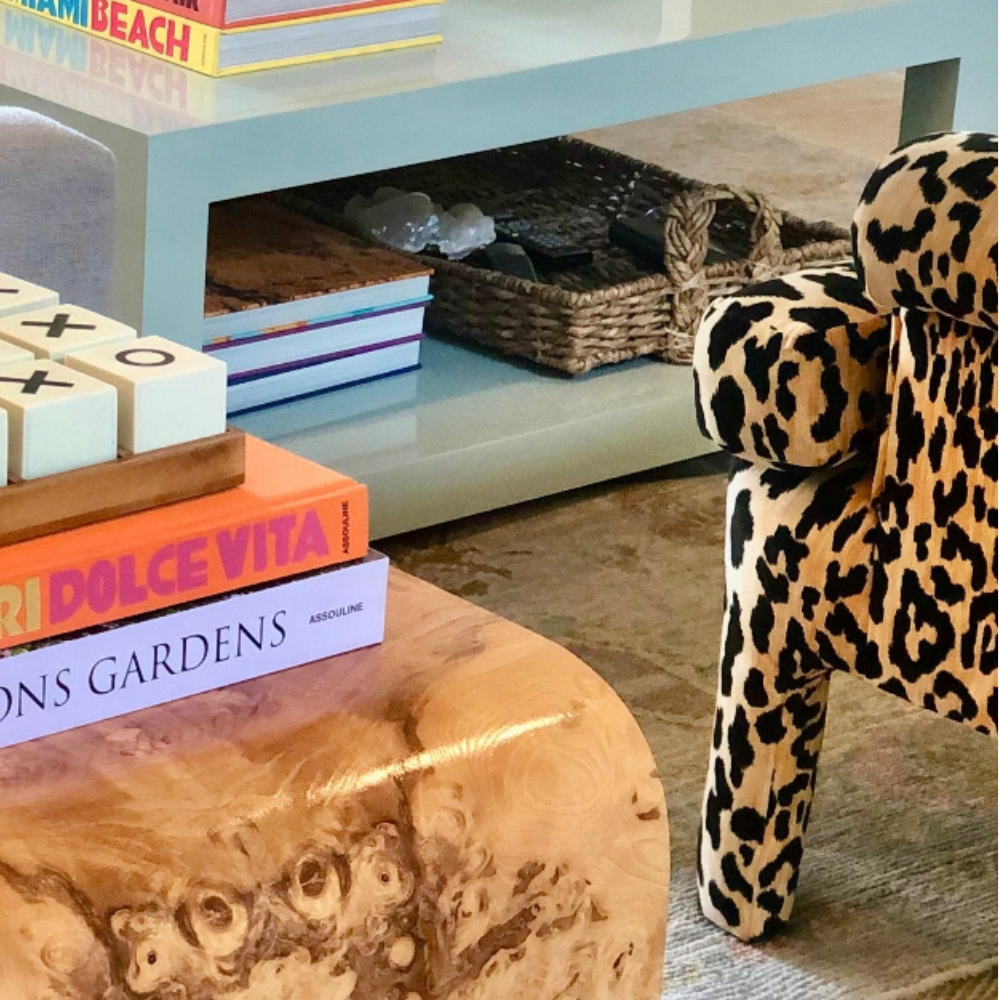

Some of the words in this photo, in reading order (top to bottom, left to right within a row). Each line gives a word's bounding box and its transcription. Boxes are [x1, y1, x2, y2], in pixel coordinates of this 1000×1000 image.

[91, 0, 191, 62] BEACH
[20, 313, 96, 338] X
[115, 348, 175, 367] O
[49, 536, 208, 625] DOLCE
[215, 508, 331, 581] VITA
[87, 609, 288, 696] GARDENS
[308, 601, 364, 625] ASSOULINE
